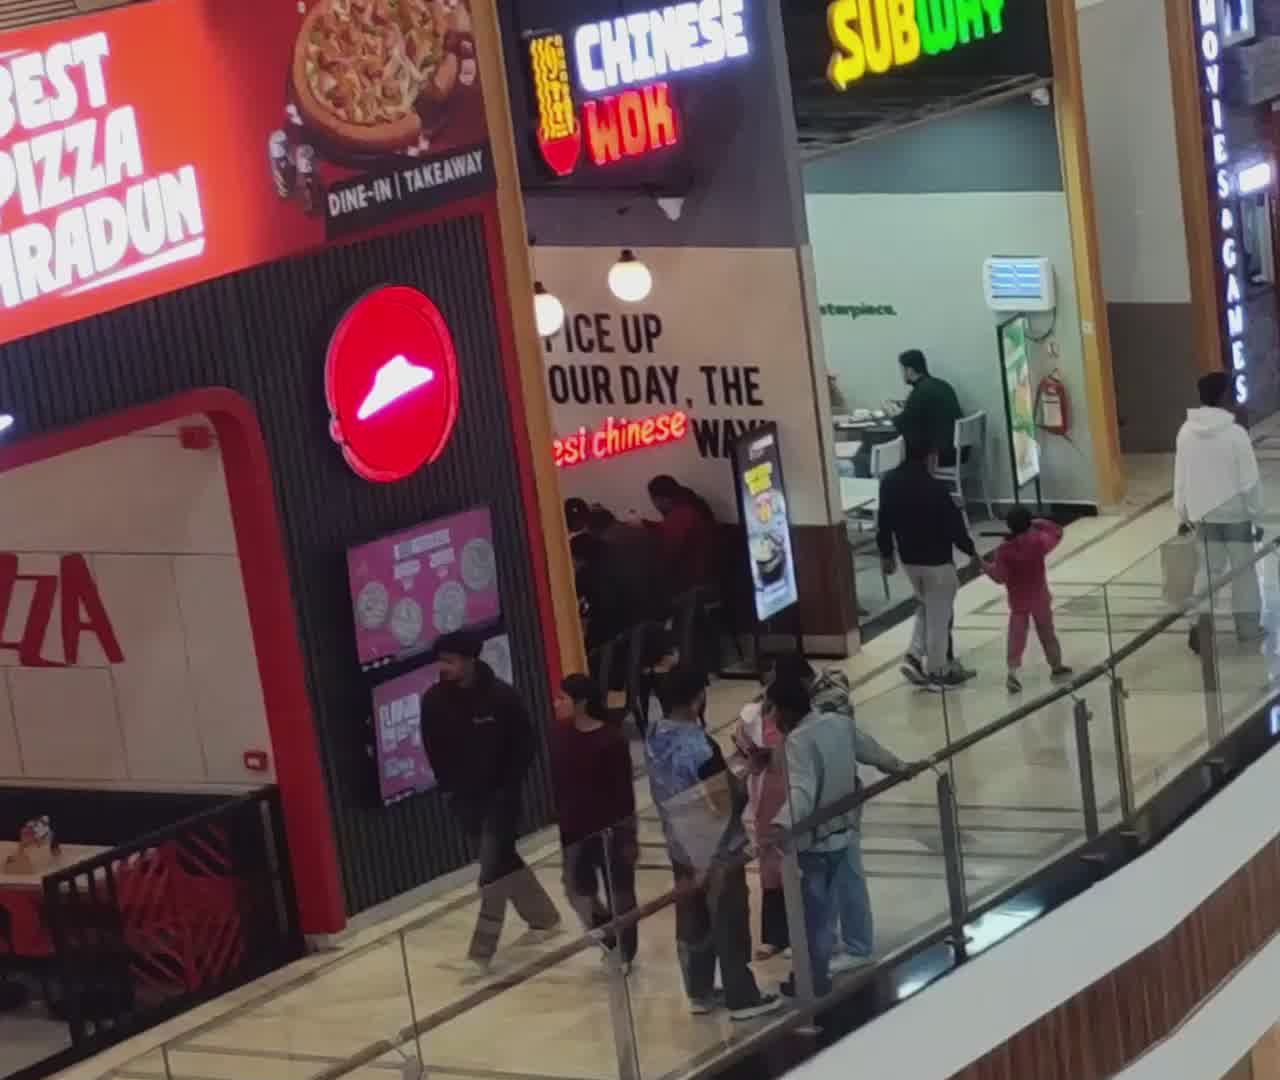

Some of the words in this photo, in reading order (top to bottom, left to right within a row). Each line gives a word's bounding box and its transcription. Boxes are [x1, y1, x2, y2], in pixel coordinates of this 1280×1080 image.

[574, 0, 749, 92] CHINESE
[583, 81, 678, 166] WOK
[327, 173, 393, 217] DINE-IN
[403, 150, 484, 193] TAKEAWAY
[621, 314, 662, 352] UP
[699, 365, 764, 407] THE
[592, 410, 688, 458] chinese
